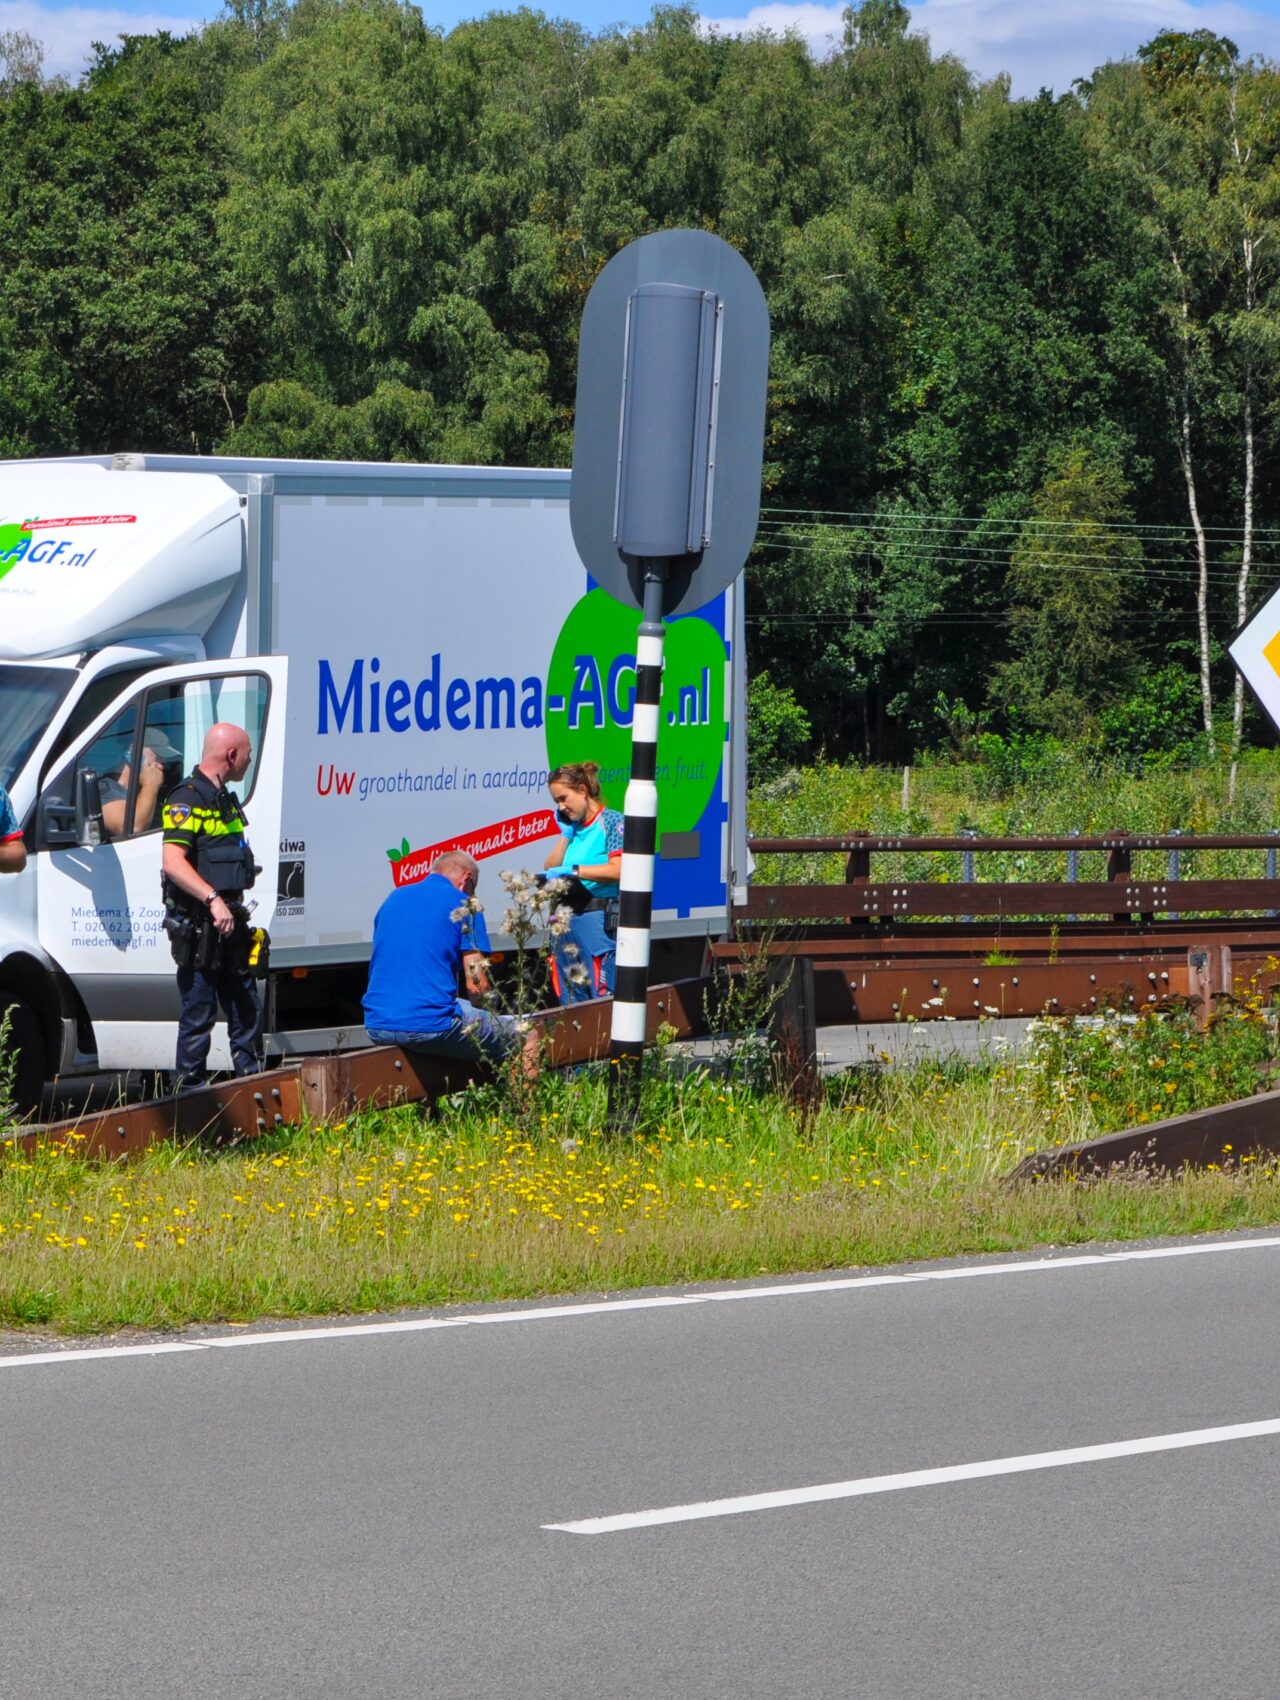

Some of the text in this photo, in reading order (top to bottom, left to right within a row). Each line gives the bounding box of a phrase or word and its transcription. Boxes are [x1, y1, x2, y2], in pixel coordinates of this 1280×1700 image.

[317, 652, 711, 735] Miedema-AG.nl
[317, 764, 356, 796] Uw
[359, 766, 458, 801] groothandel
[462, 768, 477, 790] in
[466, 824, 516, 858] smaakt
[517, 816, 551, 841] beter
[71, 906, 121, 918] Miedema
[124, 908, 135, 918] &
[288, 906, 305, 916] 22000
[84, 922, 106, 932] 020
[109, 922, 123, 932] 62
[126, 922, 140, 932] 20
[71, 936, 157, 950] miedema-agf.nl
